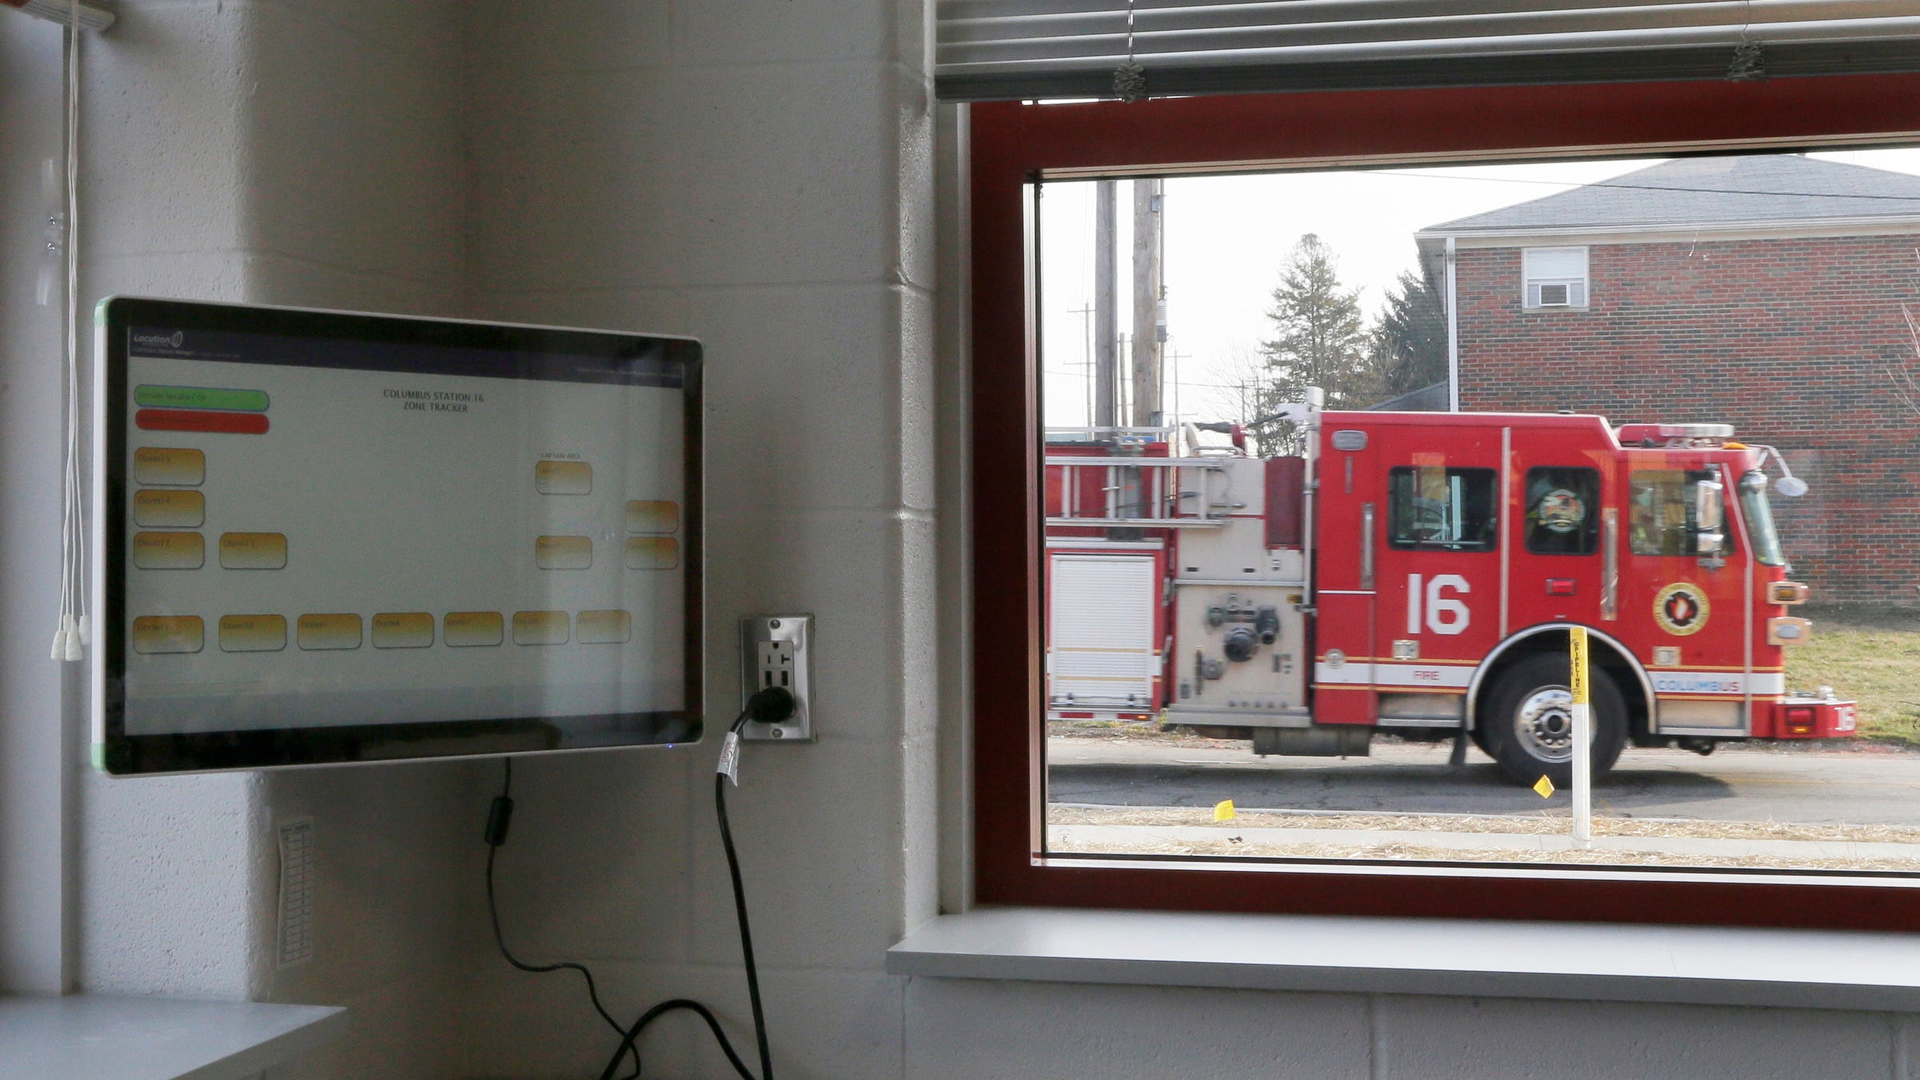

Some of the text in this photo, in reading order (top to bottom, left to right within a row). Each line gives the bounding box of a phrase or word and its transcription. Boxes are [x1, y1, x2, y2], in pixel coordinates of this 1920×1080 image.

[134, 333, 171, 344] Locution
[383, 388, 484, 402] COLUMBUS STATION 16
[403, 401, 468, 413] ZONE TRACKER
[1407, 573, 1471, 635] 16
[1413, 670, 1441, 681] FIRE
[1656, 679, 1740, 692] COLUMBUS
[1834, 706, 1856, 731] 16
